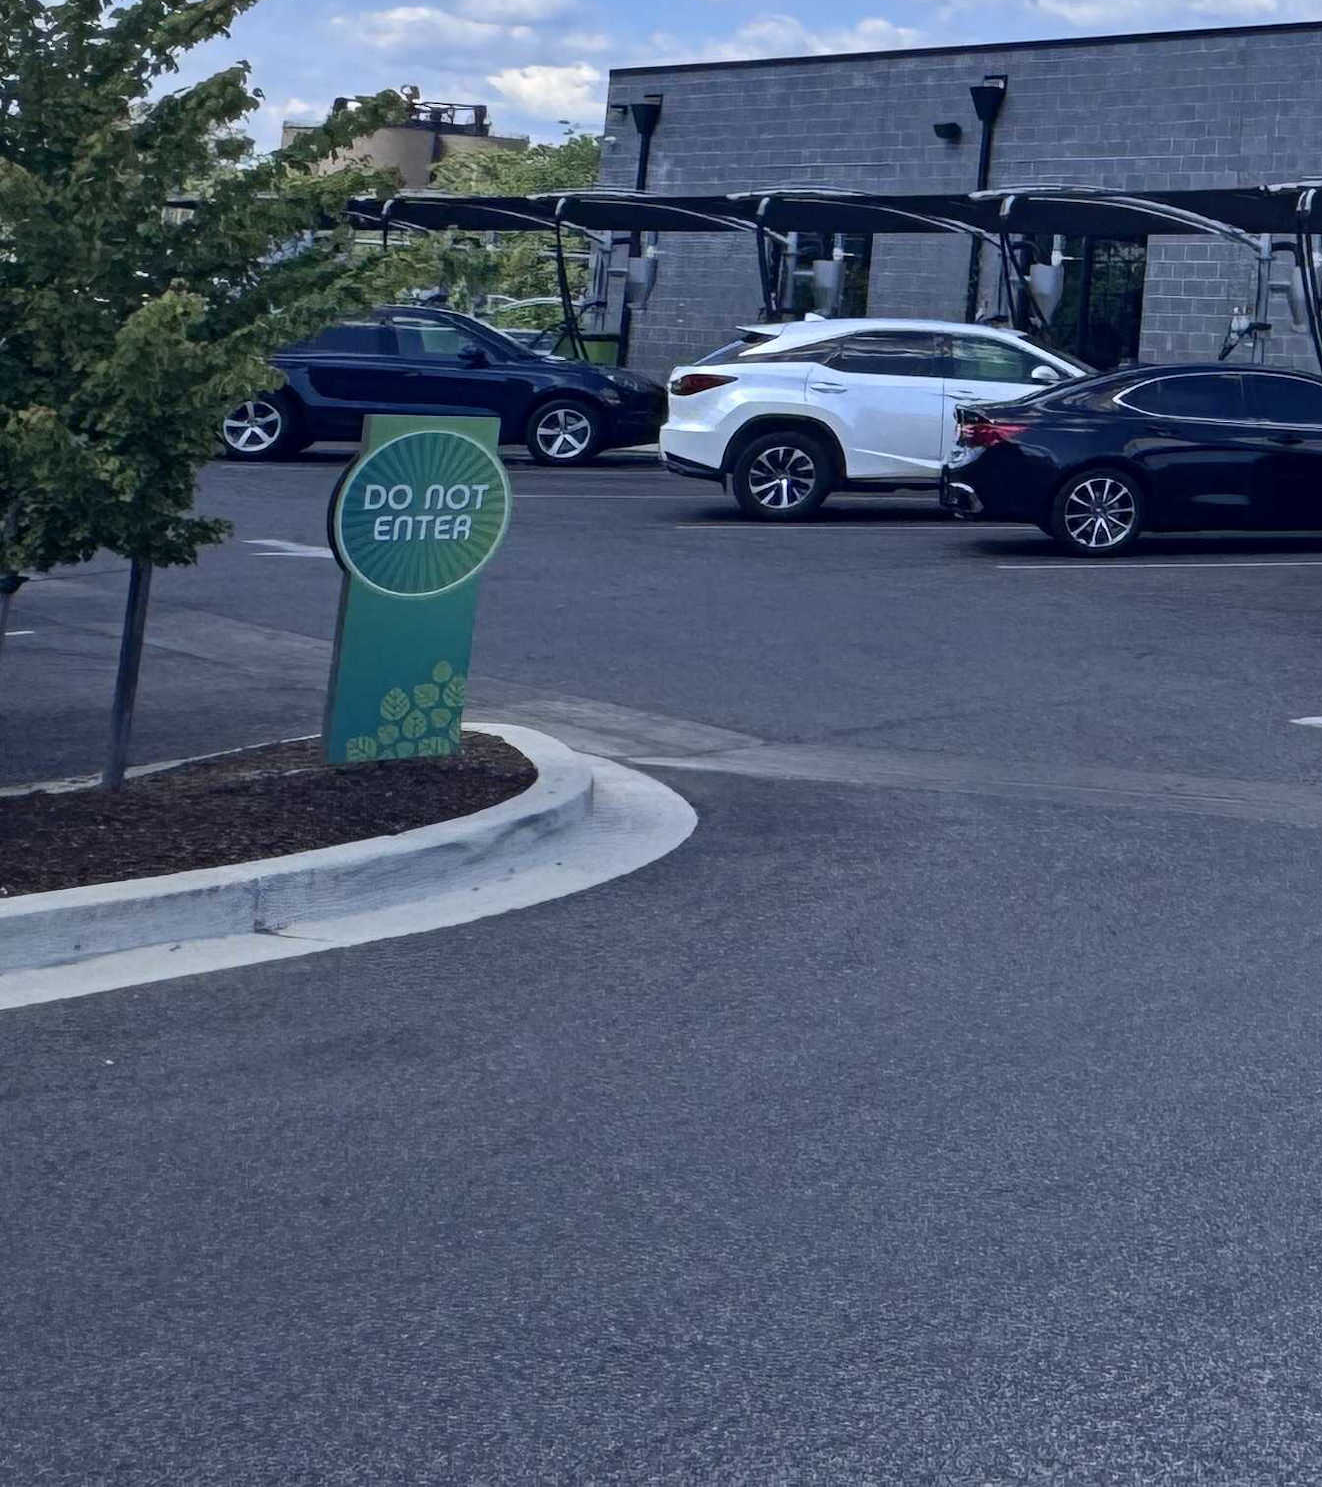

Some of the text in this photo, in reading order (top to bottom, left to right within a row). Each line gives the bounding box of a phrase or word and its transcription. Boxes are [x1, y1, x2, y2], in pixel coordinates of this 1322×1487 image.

[363, 484, 490, 511] DO NOT
[373, 515, 472, 542] ENTER
